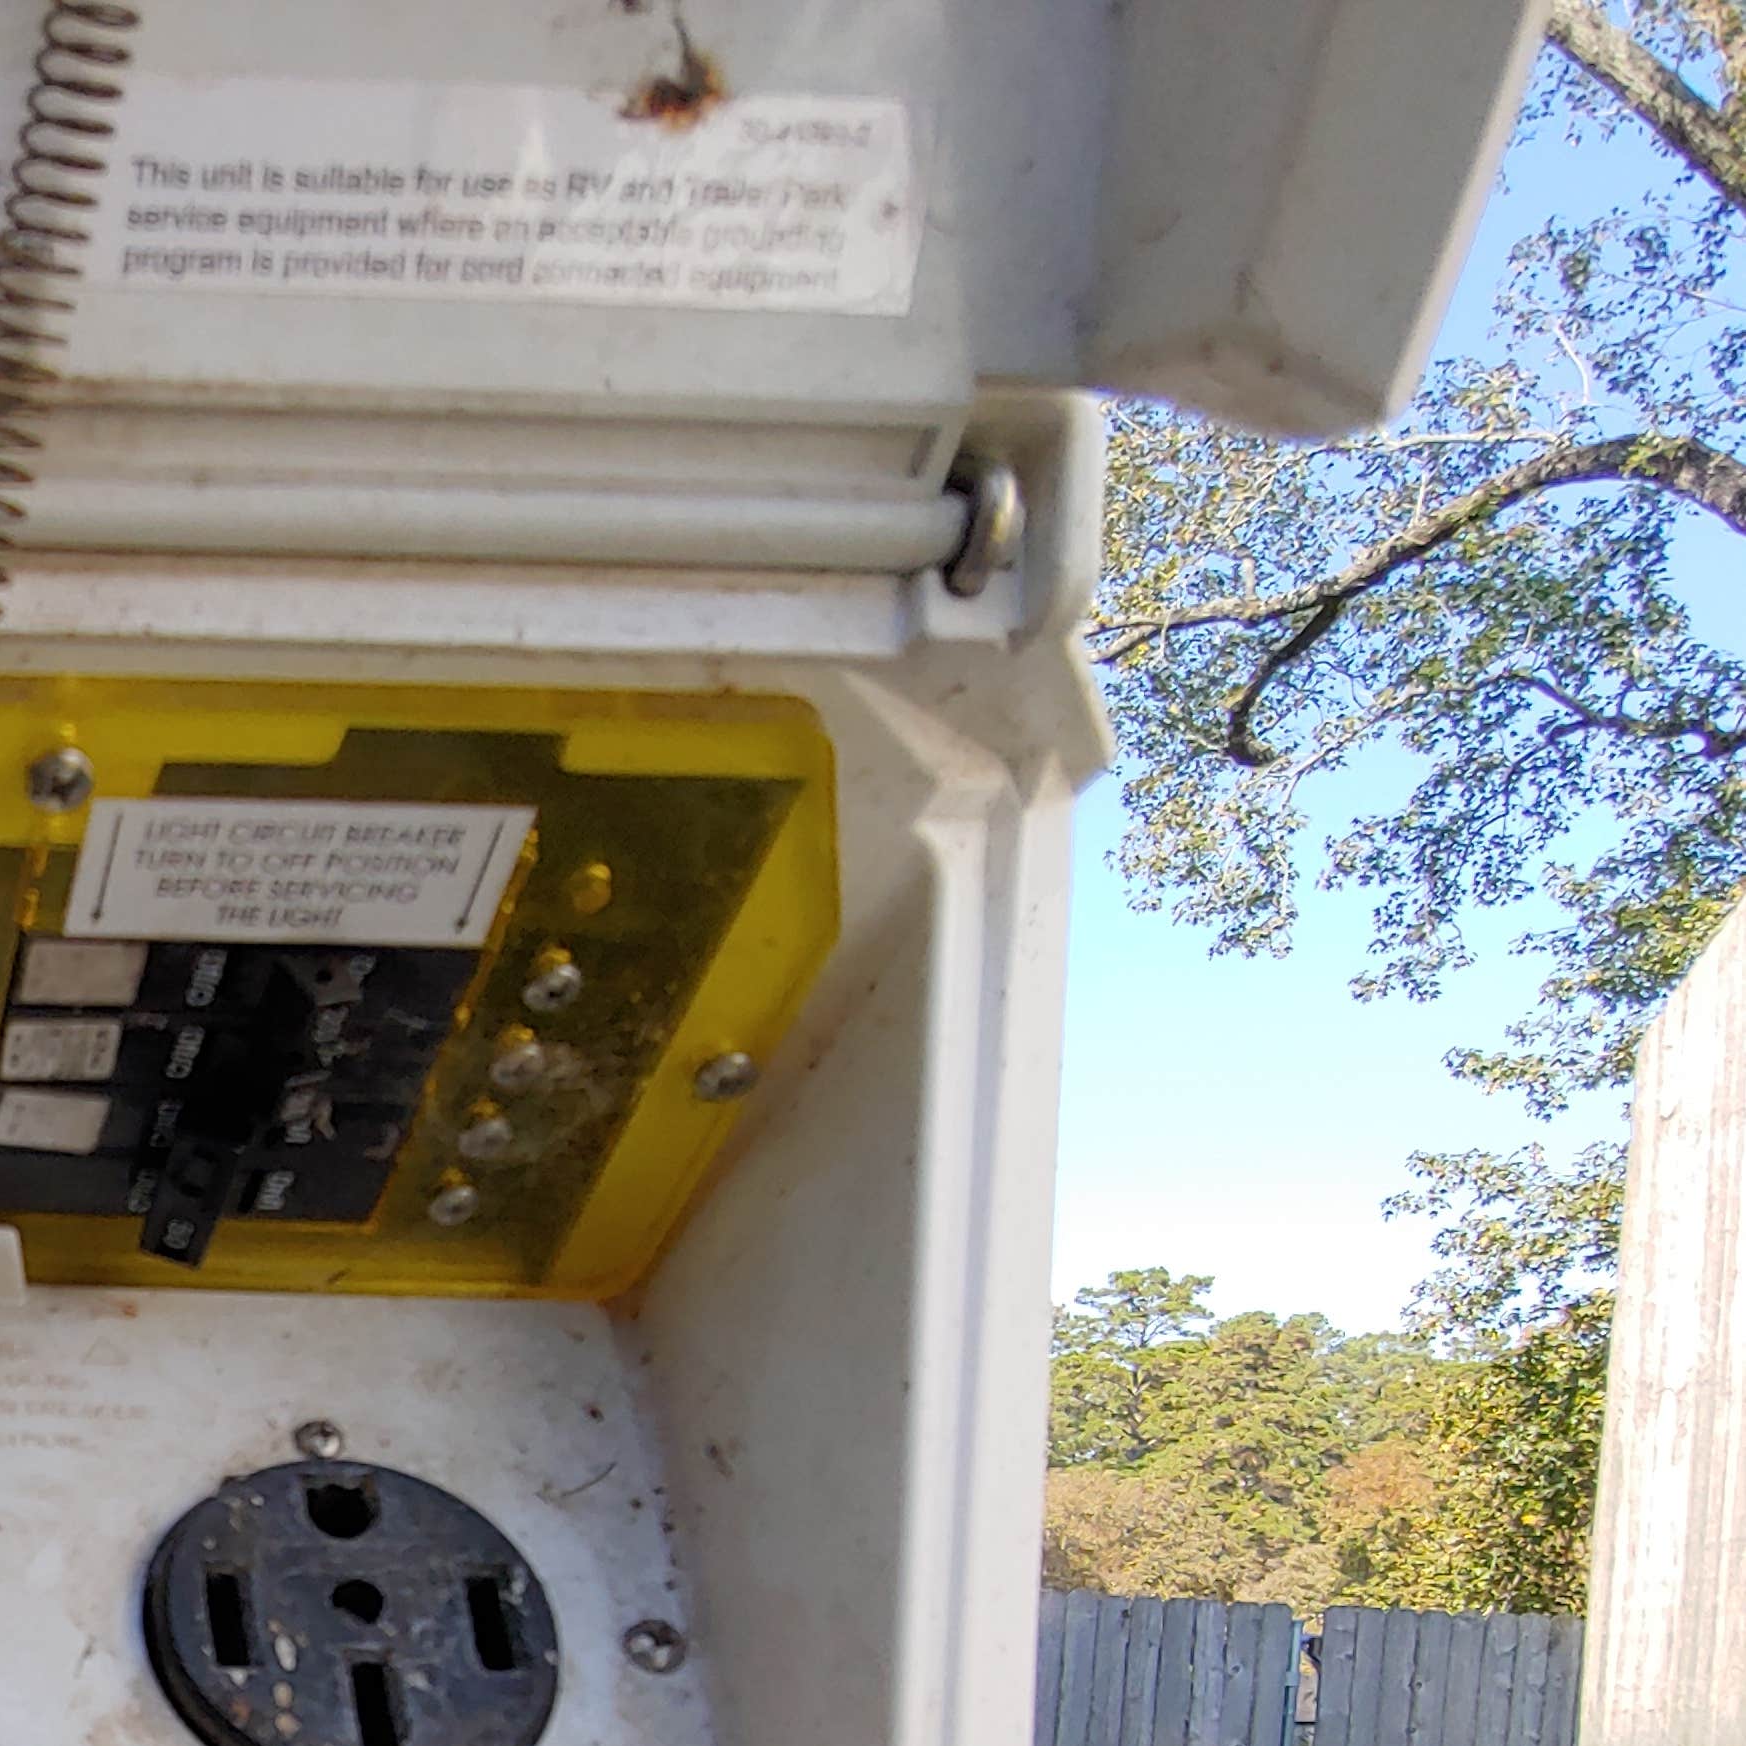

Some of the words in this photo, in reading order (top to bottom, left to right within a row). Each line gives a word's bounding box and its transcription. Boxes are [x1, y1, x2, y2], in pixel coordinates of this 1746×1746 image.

[131, 156, 190, 190] This
[201, 160, 252, 191] unit
[262, 162, 284, 192] is
[294, 163, 405, 196] suitable
[416, 165, 452, 195] for
[126, 205, 228, 232] service
[237, 207, 388, 241] equipment
[121, 249, 243, 282] program
[252, 250, 274, 274] is
[283, 251, 406, 284] provided
[416, 251, 452, 280] for
[217, 848, 255, 874] TO
[262, 851, 317, 876] OFF
[216, 904, 262, 927] THE
